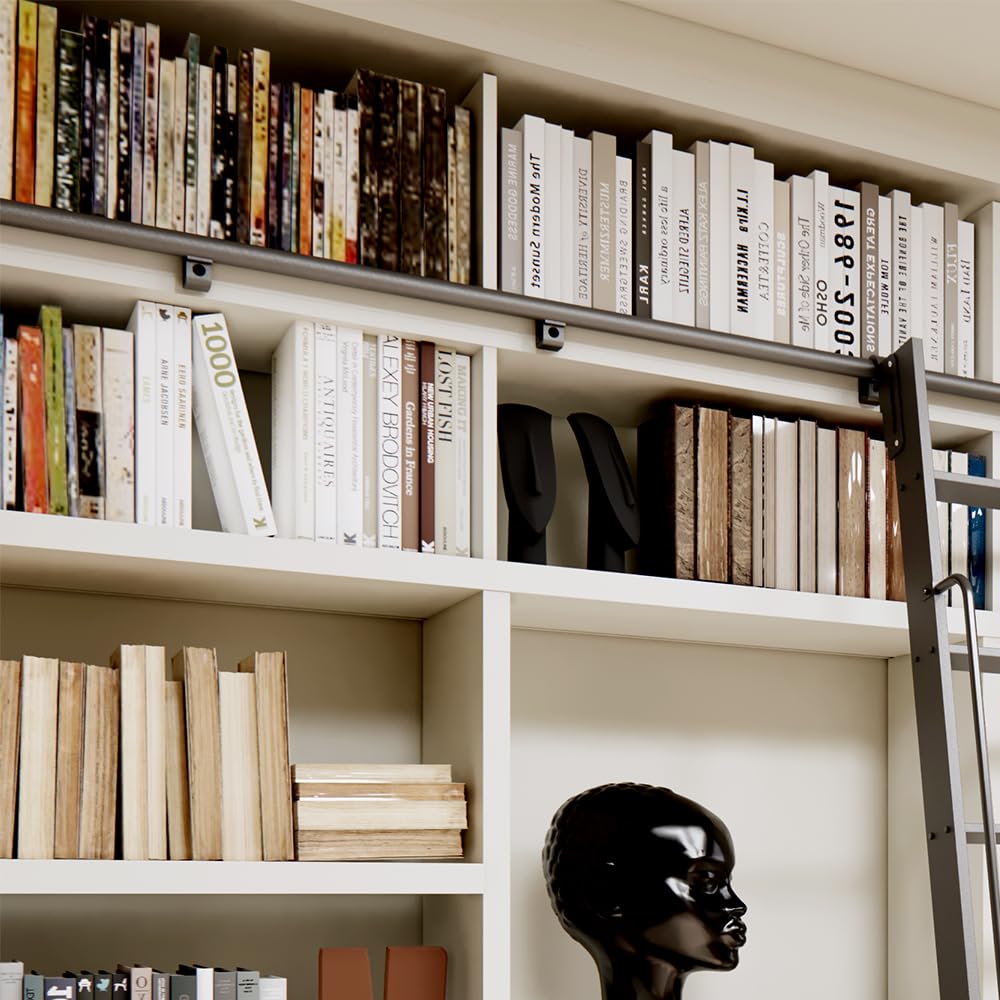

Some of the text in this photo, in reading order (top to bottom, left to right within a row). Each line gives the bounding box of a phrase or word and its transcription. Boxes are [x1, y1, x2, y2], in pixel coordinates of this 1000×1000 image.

[201, 322, 237, 389] 1000
[438, 350, 453, 443] LOST FISH
[457, 364, 467, 433] MAKING IT
[160, 383, 169, 426] JACOBSEN
[320, 375, 335, 488] ANTIQUAIRES
[382, 334, 400, 539] ALEXEY BRODOVITCH
[426, 382, 435, 464] NEW URBAN HOUSING
[405, 401, 416, 496] Gardens in France
